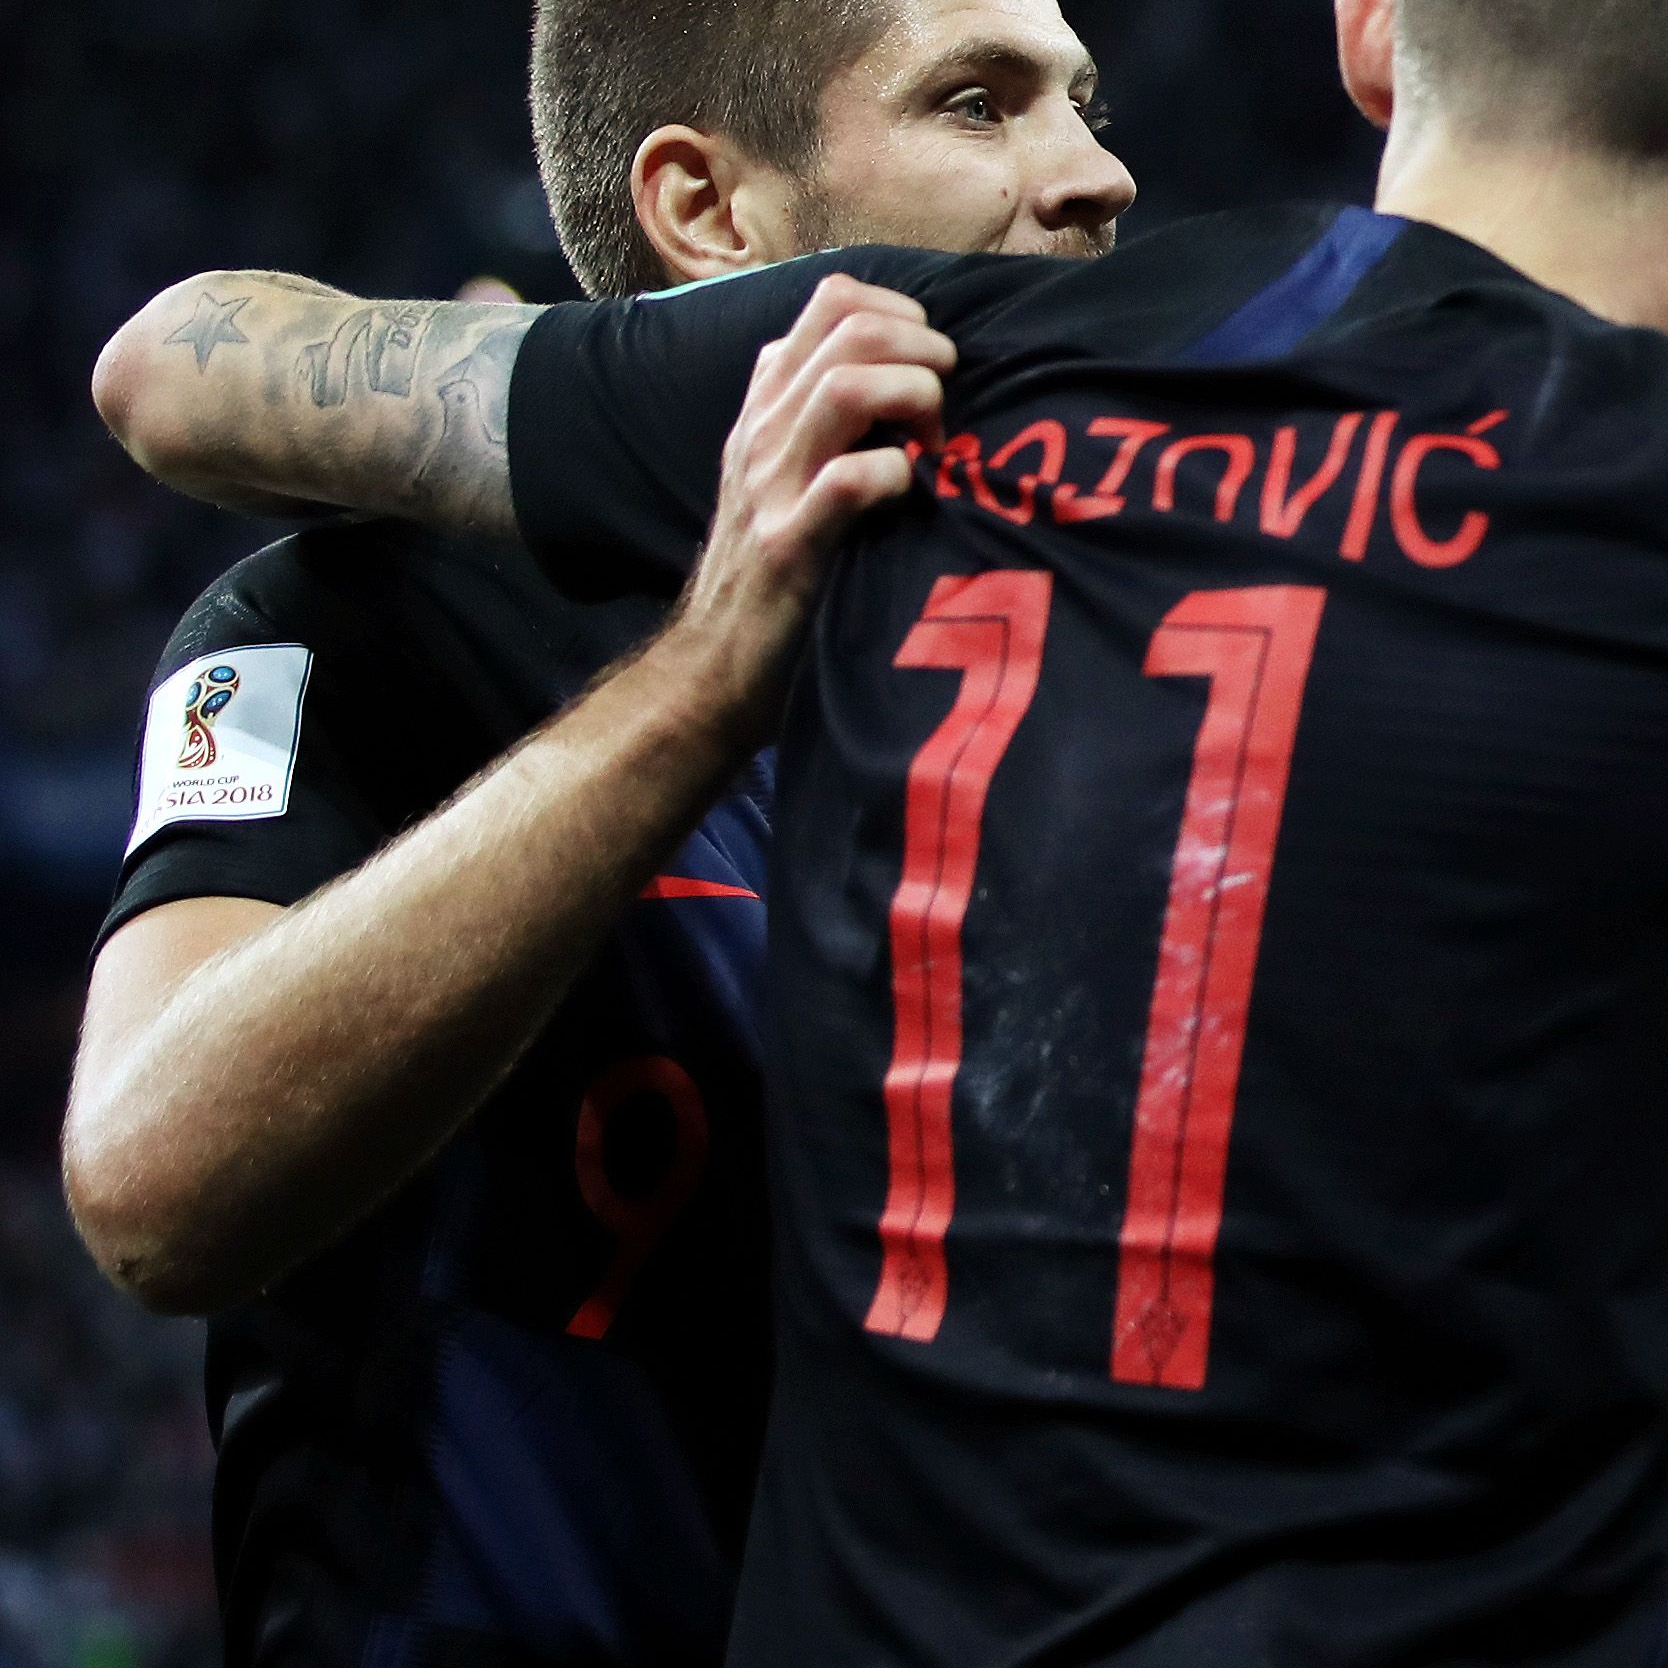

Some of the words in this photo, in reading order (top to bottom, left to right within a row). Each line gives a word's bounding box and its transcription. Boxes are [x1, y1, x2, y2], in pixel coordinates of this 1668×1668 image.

[903, 409, 1509, 570] ROZOVIĆ
[173, 778, 215, 788] WORLD
[217, 775, 240, 785] CUP
[211, 784, 273, 805] 2018
[863, 568, 1328, 1391] 11
[565, 1054, 708, 1340] 9
